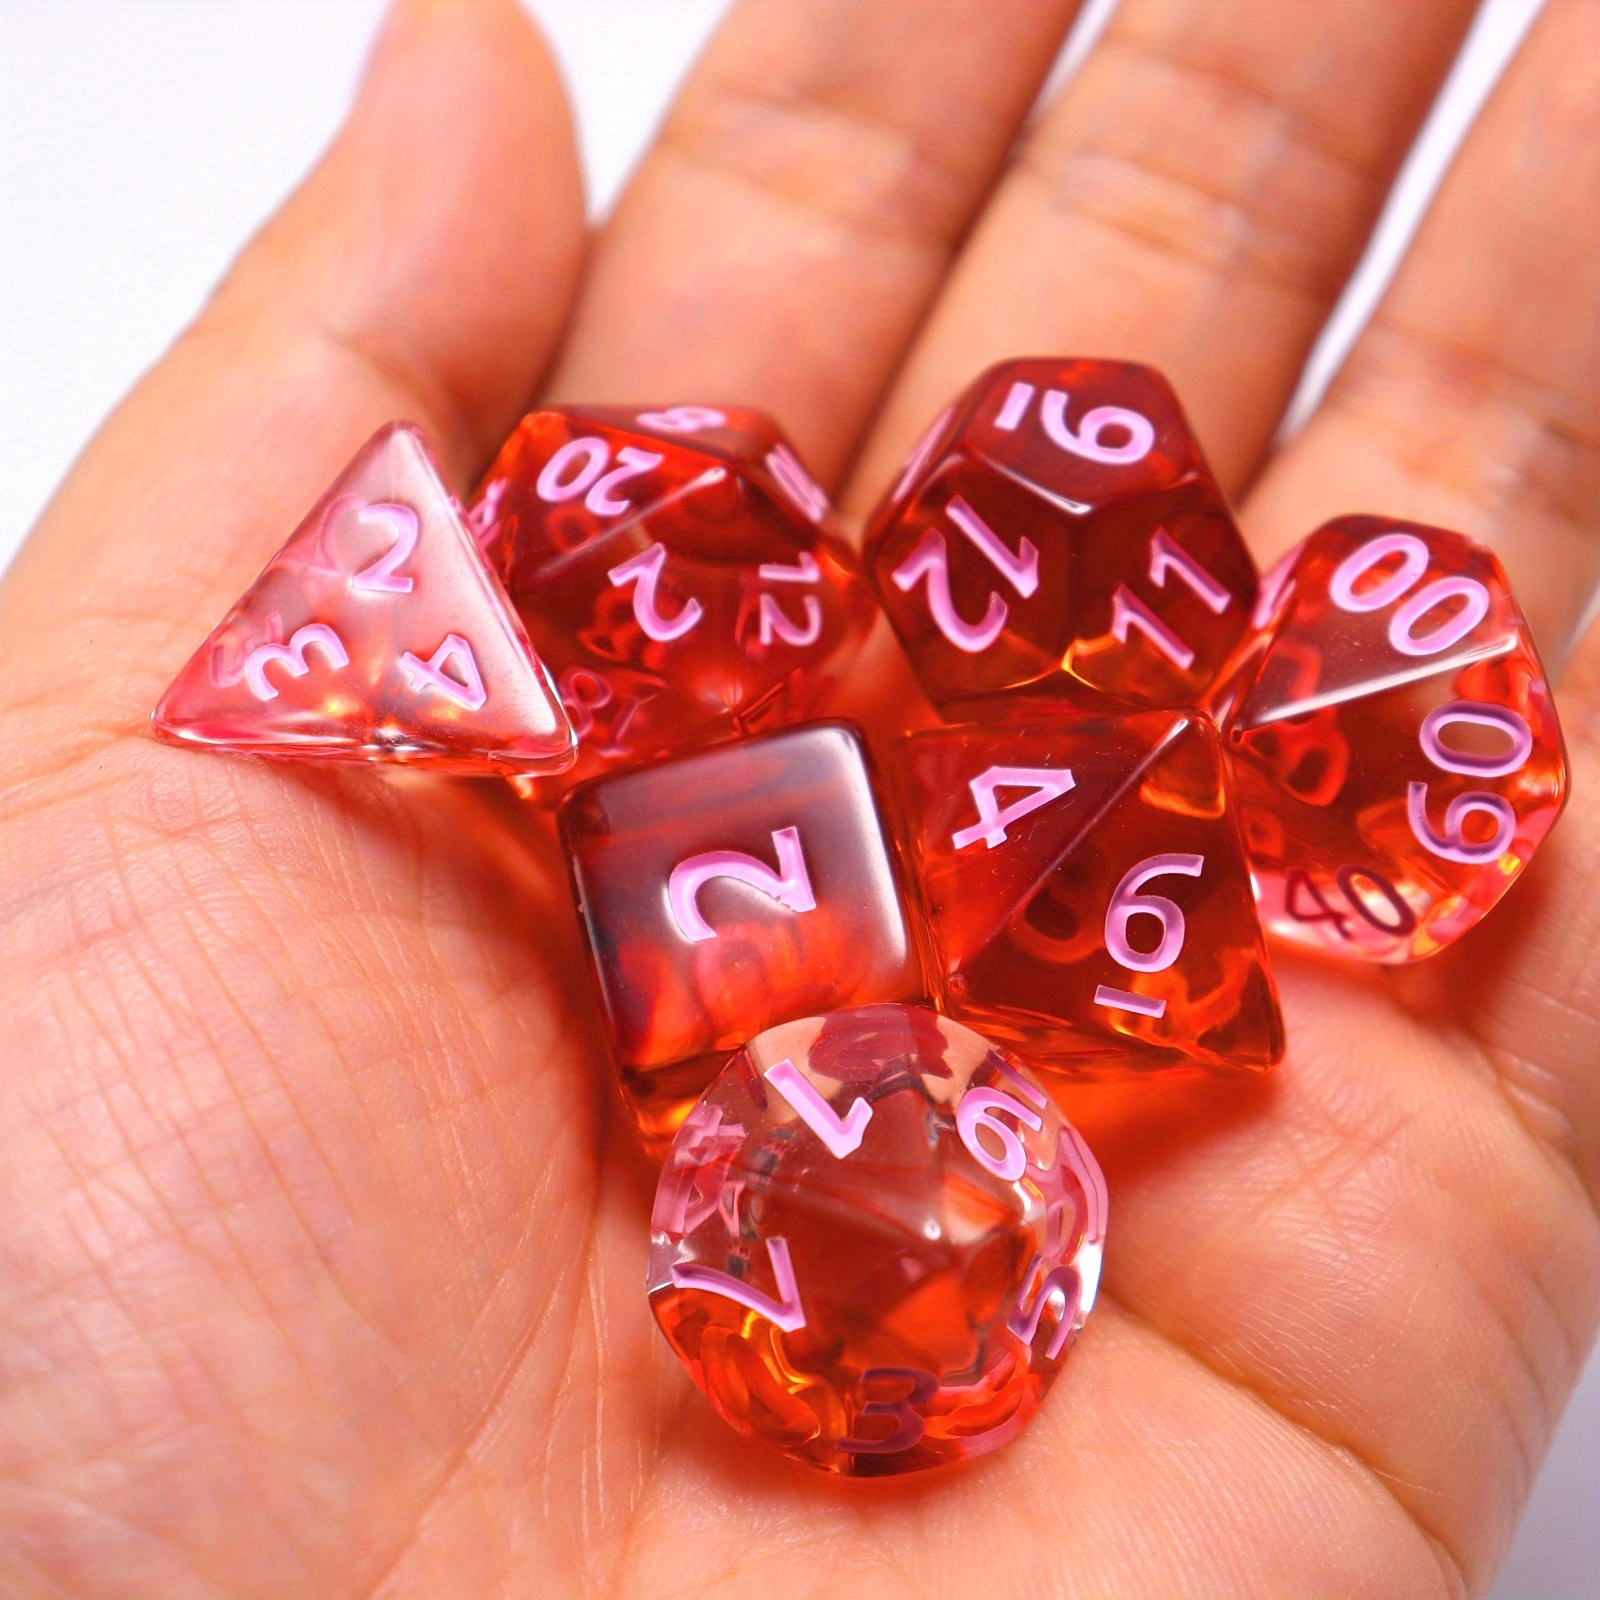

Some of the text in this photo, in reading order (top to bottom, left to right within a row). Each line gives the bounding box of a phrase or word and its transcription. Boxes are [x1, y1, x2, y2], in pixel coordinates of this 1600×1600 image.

[537, 437, 665, 516] 20
[350, 503, 419, 594] 2
[607, 542, 704, 643] 2
[891, 494, 1039, 653] 12
[1329, 533, 1490, 656] 00
[759, 551, 823, 647] 12
[1112, 526, 1232, 671] 11
[244, 622, 350, 701] 3
[399, 633, 488, 712] 4
[951, 764, 1077, 851] 4
[667, 825, 818, 943] 2
[763, 1057, 874, 1160] 1
[671, 1235, 808, 1334] 7
[1006, 1250, 1082, 1361] 5
[834, 1366, 941, 1454] 3
